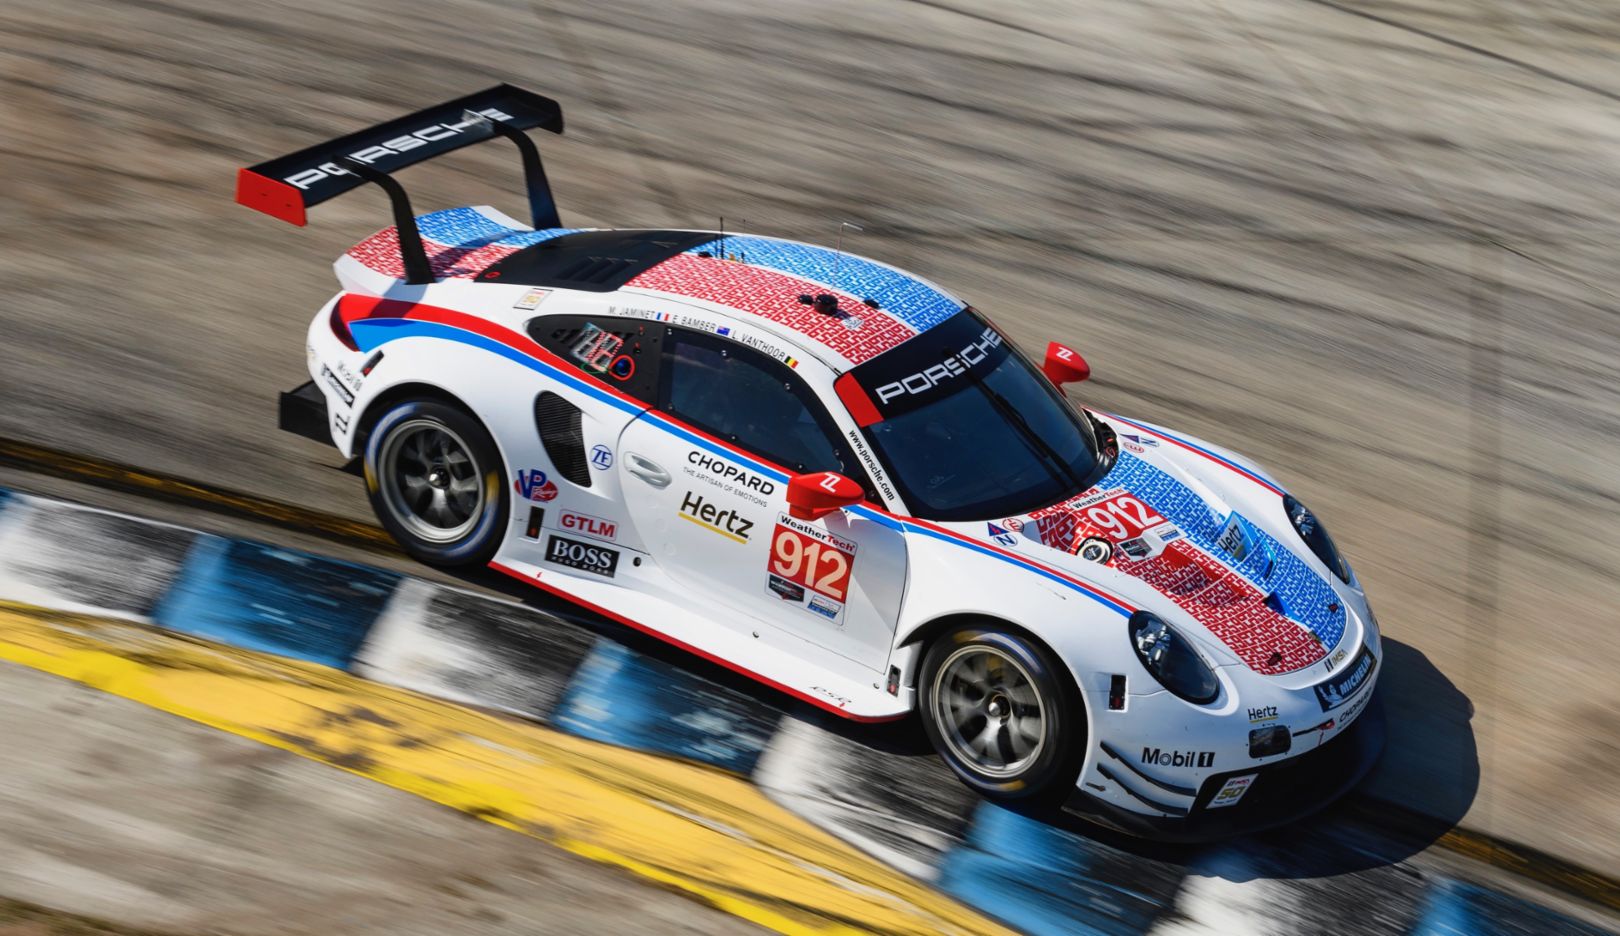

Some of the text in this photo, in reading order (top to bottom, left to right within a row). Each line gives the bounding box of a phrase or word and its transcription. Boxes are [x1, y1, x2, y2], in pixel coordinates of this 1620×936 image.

[682, 316, 716, 332] BAMBER
[741, 334, 786, 361] VANTHOOR
[875, 327, 1003, 405] PORSCHE
[591, 448, 611, 465] ZF
[848, 429, 896, 501] www.porsche.com
[518, 468, 547, 499] VP
[688, 450, 775, 496] CHOPARD
[734, 486, 768, 508] EMOTIONS
[561, 513, 616, 538] GTLM
[680, 490, 754, 539] Hertz
[1088, 497, 1163, 540] 912
[781, 515, 856, 552] WeatherTech
[1218, 524, 1245, 553] Hertz
[553, 539, 612, 569] BOSS
[773, 531, 848, 600] 912
[1340, 655, 1372, 695] MICHELIN
[1247, 705, 1279, 721] Hertz
[1141, 747, 1195, 768] Mobil
